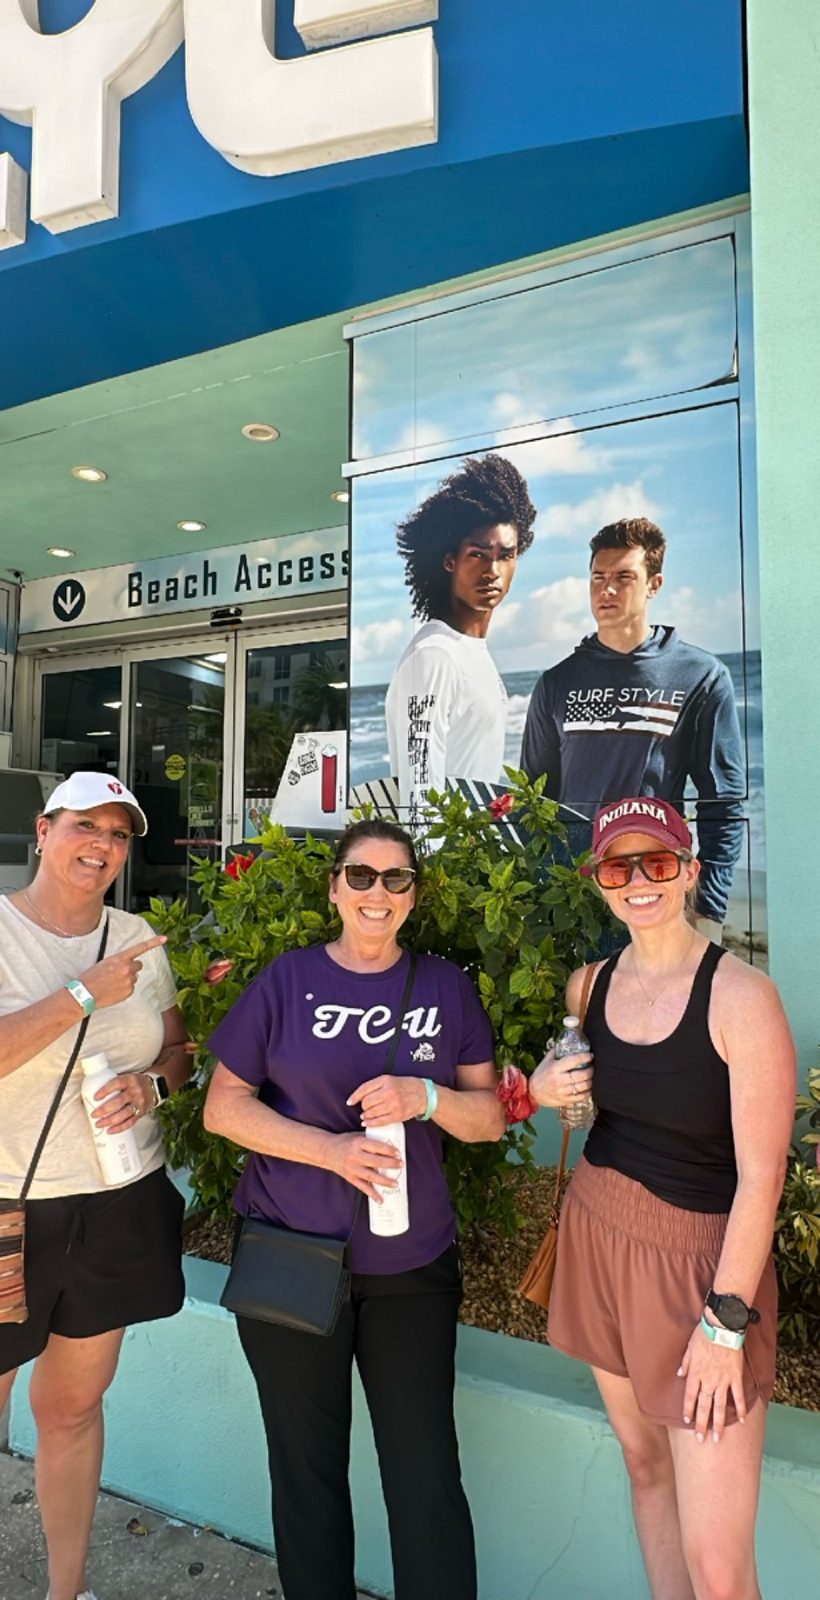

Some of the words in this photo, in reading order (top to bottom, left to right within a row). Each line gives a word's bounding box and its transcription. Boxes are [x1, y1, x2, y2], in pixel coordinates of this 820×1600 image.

[128, 560, 217, 608] Beach
[566, 688, 615, 704] SURF
[618, 687, 686, 706] STYLE
[599, 801, 668, 832] INDIANA
[312, 1004, 442, 1044] TCU
